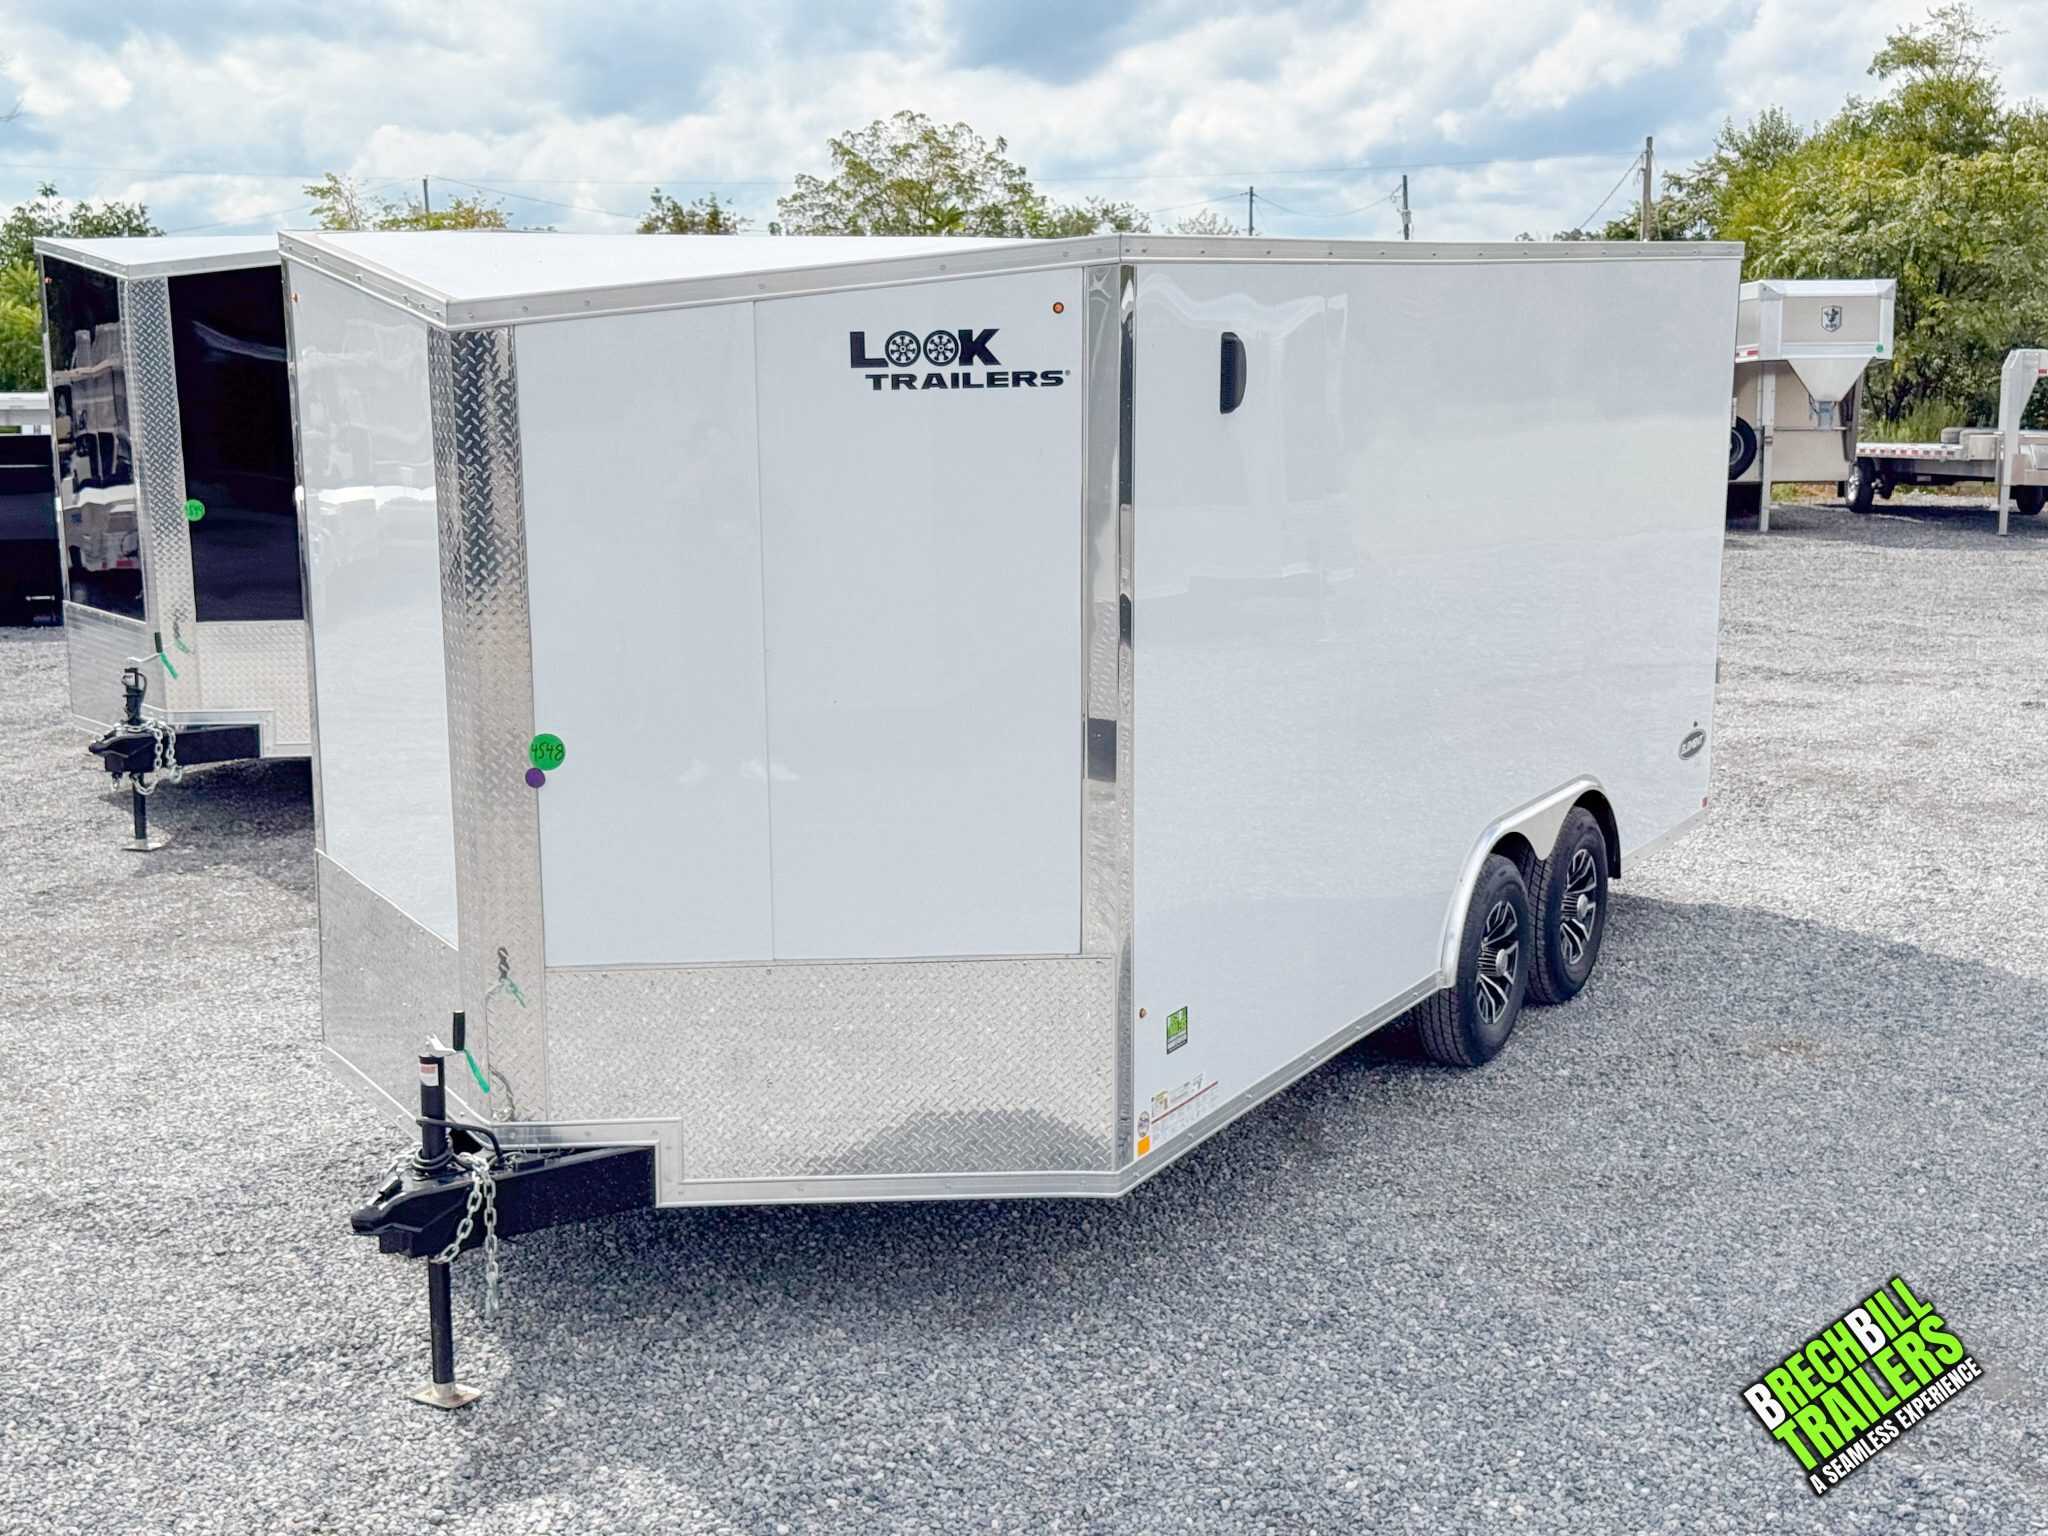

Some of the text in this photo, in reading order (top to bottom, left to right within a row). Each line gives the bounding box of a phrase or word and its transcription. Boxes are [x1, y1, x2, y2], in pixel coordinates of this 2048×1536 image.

[850, 328, 1002, 368] LOOK
[865, 370, 1065, 390] TRAILERS
[531, 741, 564, 761] 4548
